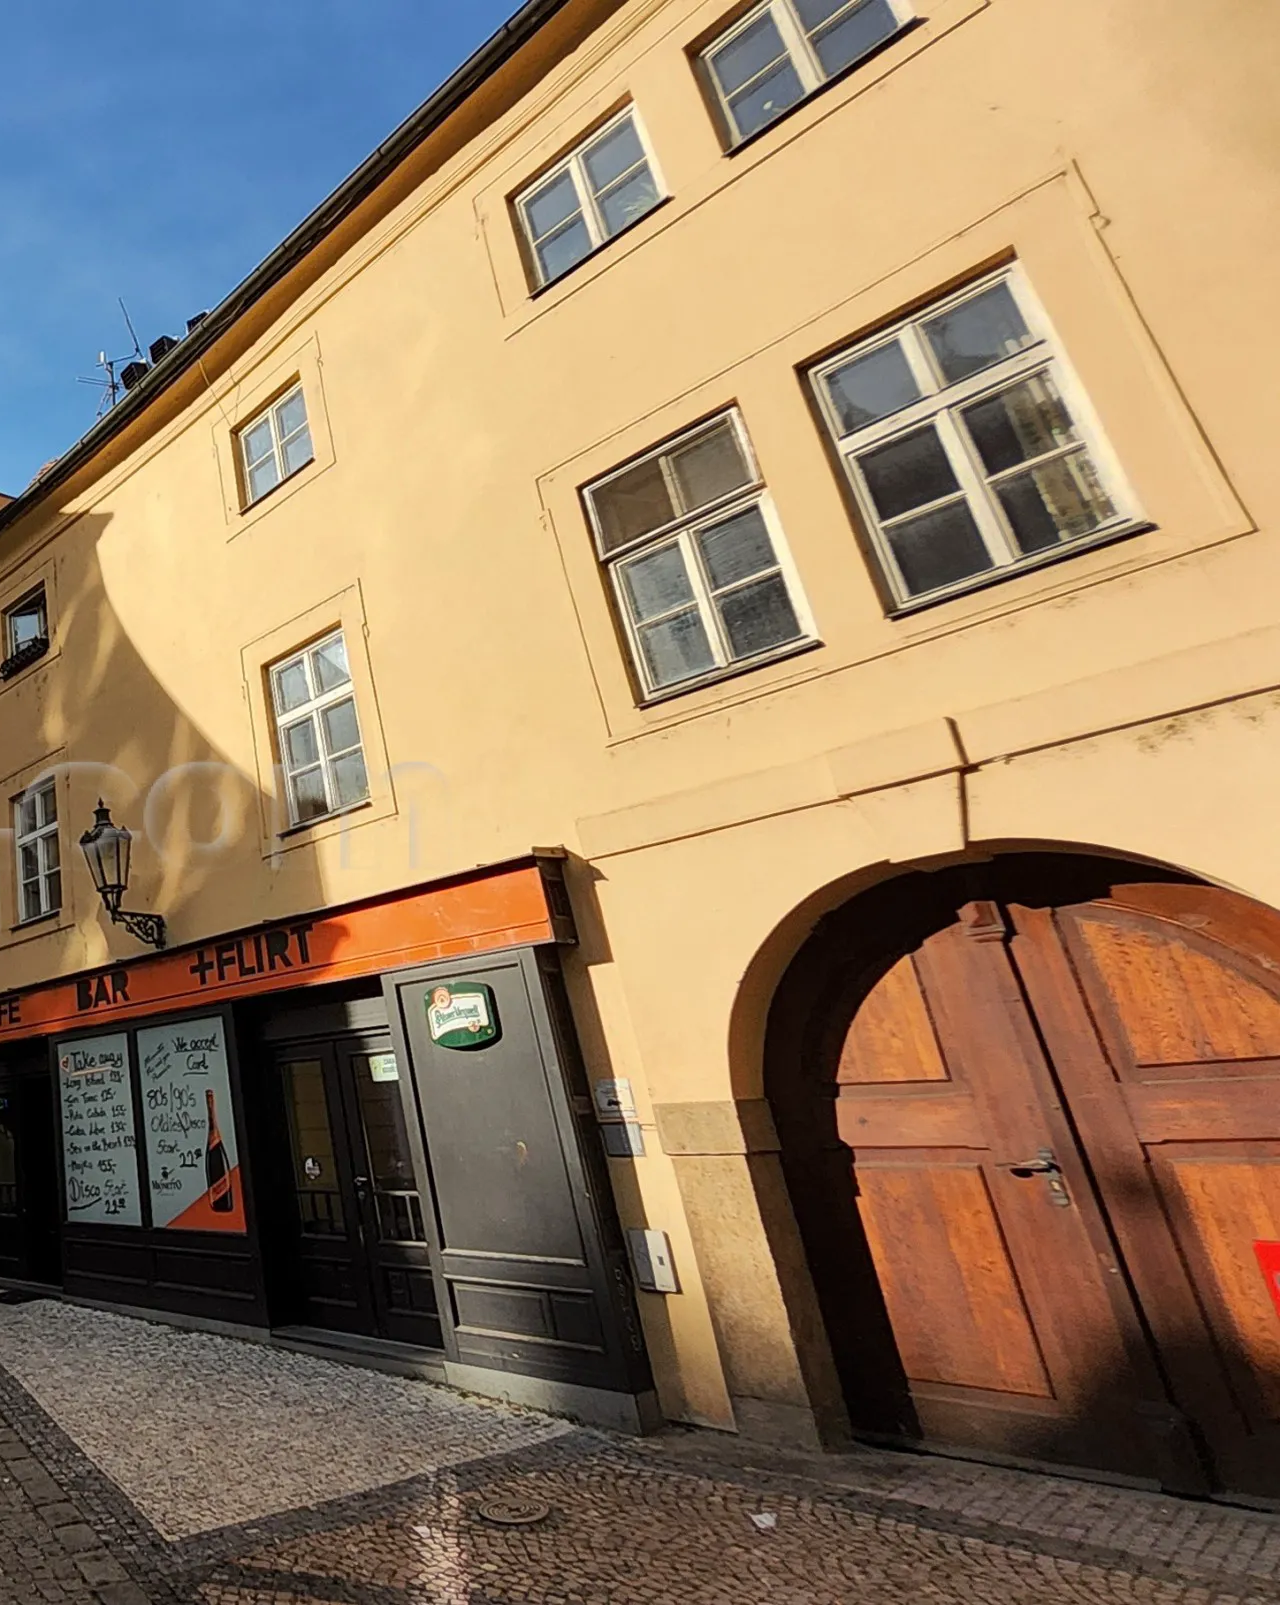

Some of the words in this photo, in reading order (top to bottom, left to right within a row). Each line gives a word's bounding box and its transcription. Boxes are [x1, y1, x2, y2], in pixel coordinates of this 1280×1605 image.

[76, 970, 131, 1012] BAR
[189, 923, 315, 987] +FLIRT
[70, 1050, 97, 1072] Take
[99, 1052, 124, 1068] away
[68, 1176, 101, 1203] Disco
